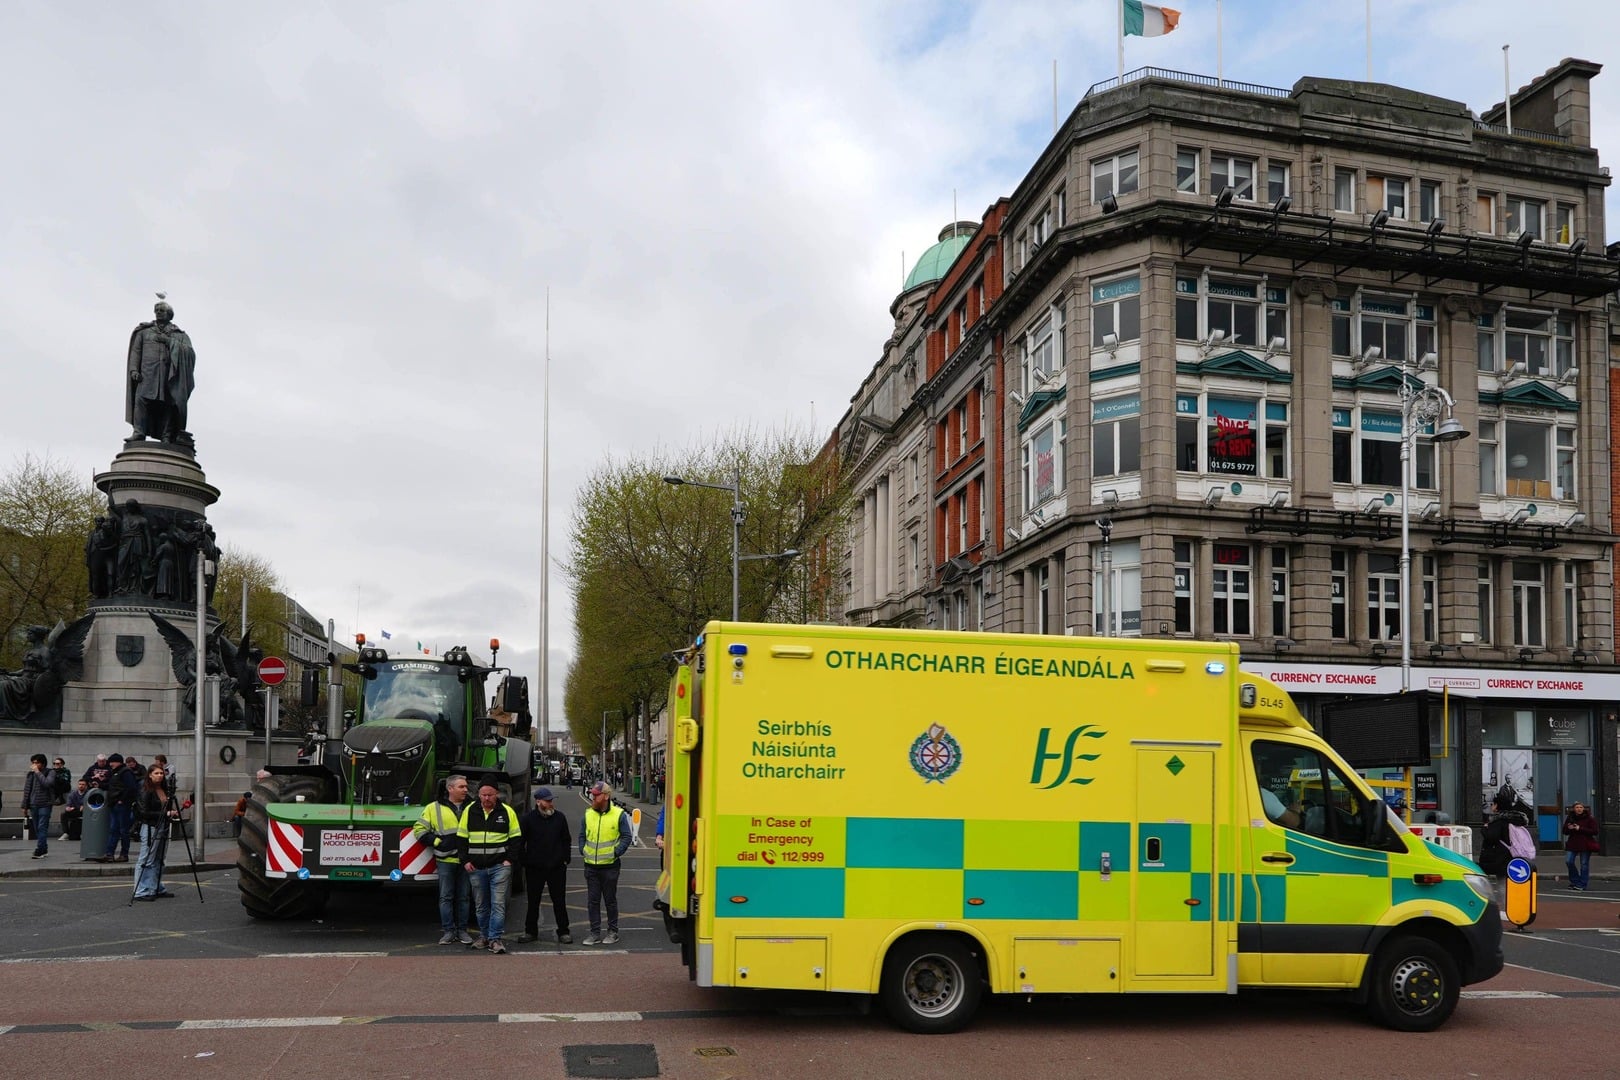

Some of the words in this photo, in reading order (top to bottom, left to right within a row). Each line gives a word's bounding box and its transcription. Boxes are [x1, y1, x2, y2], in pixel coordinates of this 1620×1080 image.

[1099, 282, 1134, 298] tcube
[1106, 402, 1136, 412] O'Connell
[1216, 414, 1249, 438] SPACE
[1215, 440, 1227, 457] TO
[1229, 438, 1252, 457] RENT
[1211, 461, 1220, 469] 01
[1222, 462, 1236, 470] 675
[1237, 463, 1255, 471] 9777
[1217, 549, 1242, 563] UP
[391, 663, 440, 672] CHAMBERS
[825, 650, 985, 674] OTHARCHARR
[995, 652, 1135, 679] ÉIGEANDÁLA
[1270, 672, 1322, 684] CURRENCY
[1325, 674, 1377, 685] EXCHANGE
[1487, 679, 1534, 689] CURRENCY
[1537, 680, 1584, 690] EXCHANGE
[1260, 697, 1284, 709] 5L45
[757, 719, 832, 737] Seirbhís
[1548, 716, 1577, 729] tcube
[752, 740, 836, 758] Náisiúnta
[1030, 724, 1109, 790] HSE
[742, 762, 846, 780] Otharchairr
[751, 817, 762, 827] In
[766, 817, 796, 828] Case
[800, 817, 812, 828] of
[323, 832, 381, 840] CHAMBERS
[748, 833, 814, 847] Emergency
[737, 851, 758, 862] dial
